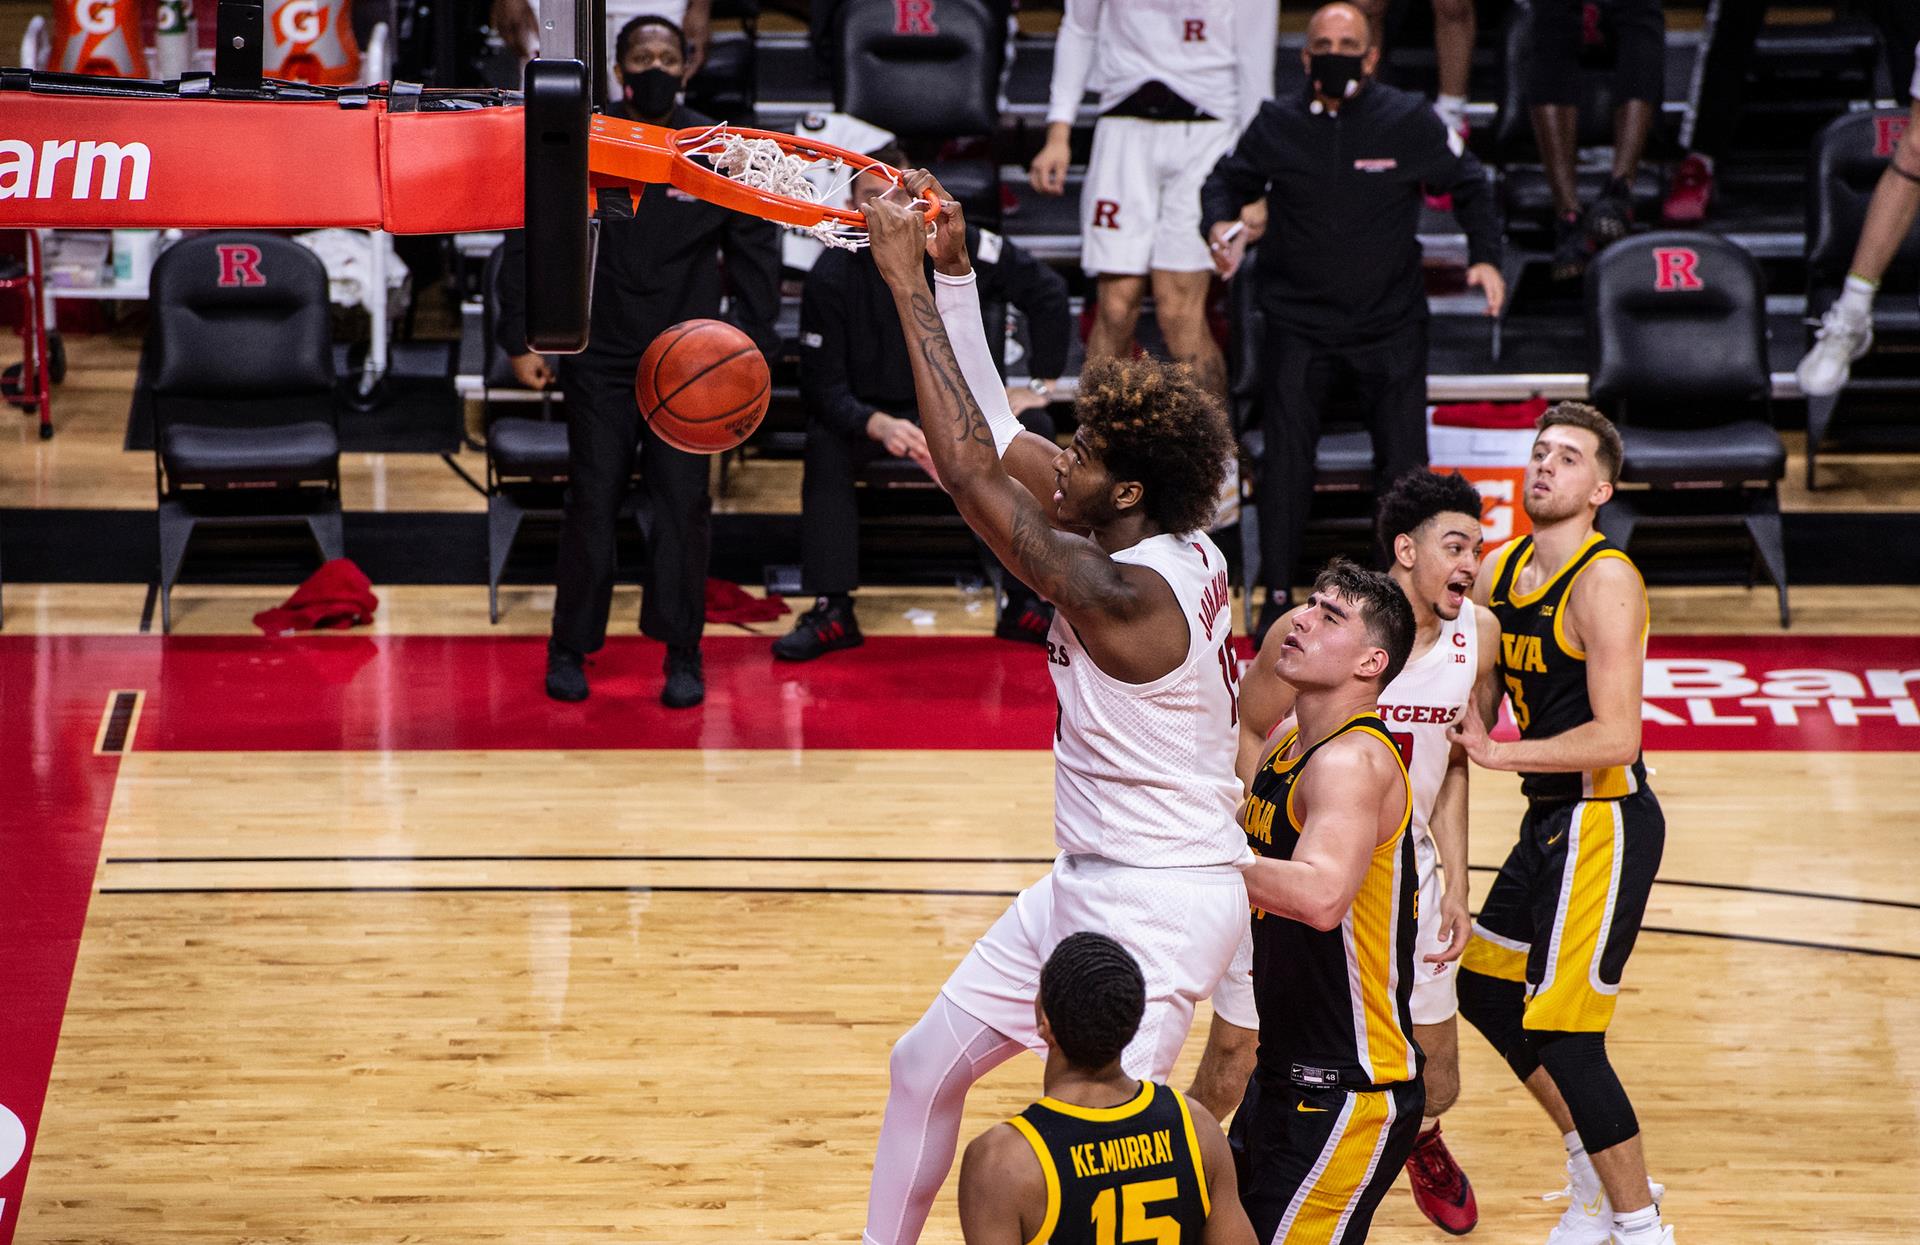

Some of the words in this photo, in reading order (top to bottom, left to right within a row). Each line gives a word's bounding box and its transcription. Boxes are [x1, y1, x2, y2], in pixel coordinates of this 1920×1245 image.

[74, 0, 117, 35] G
[279, 0, 321, 43] G
[894, 0, 939, 36] R
[1183, 19, 1206, 42] R
[0, 139, 151, 200] arm
[1092, 199, 1120, 229] R
[217, 244, 266, 287] R
[1652, 247, 1703, 292] R
[1452, 632, 1467, 648] C
[1376, 704, 1460, 724] TGERS
[1244, 794, 1277, 845] OWA
[1325, 1073, 1336, 1081] 48
[1070, 1129, 1174, 1178] KE.MURRAY
[1091, 1177, 1181, 1245] 15
